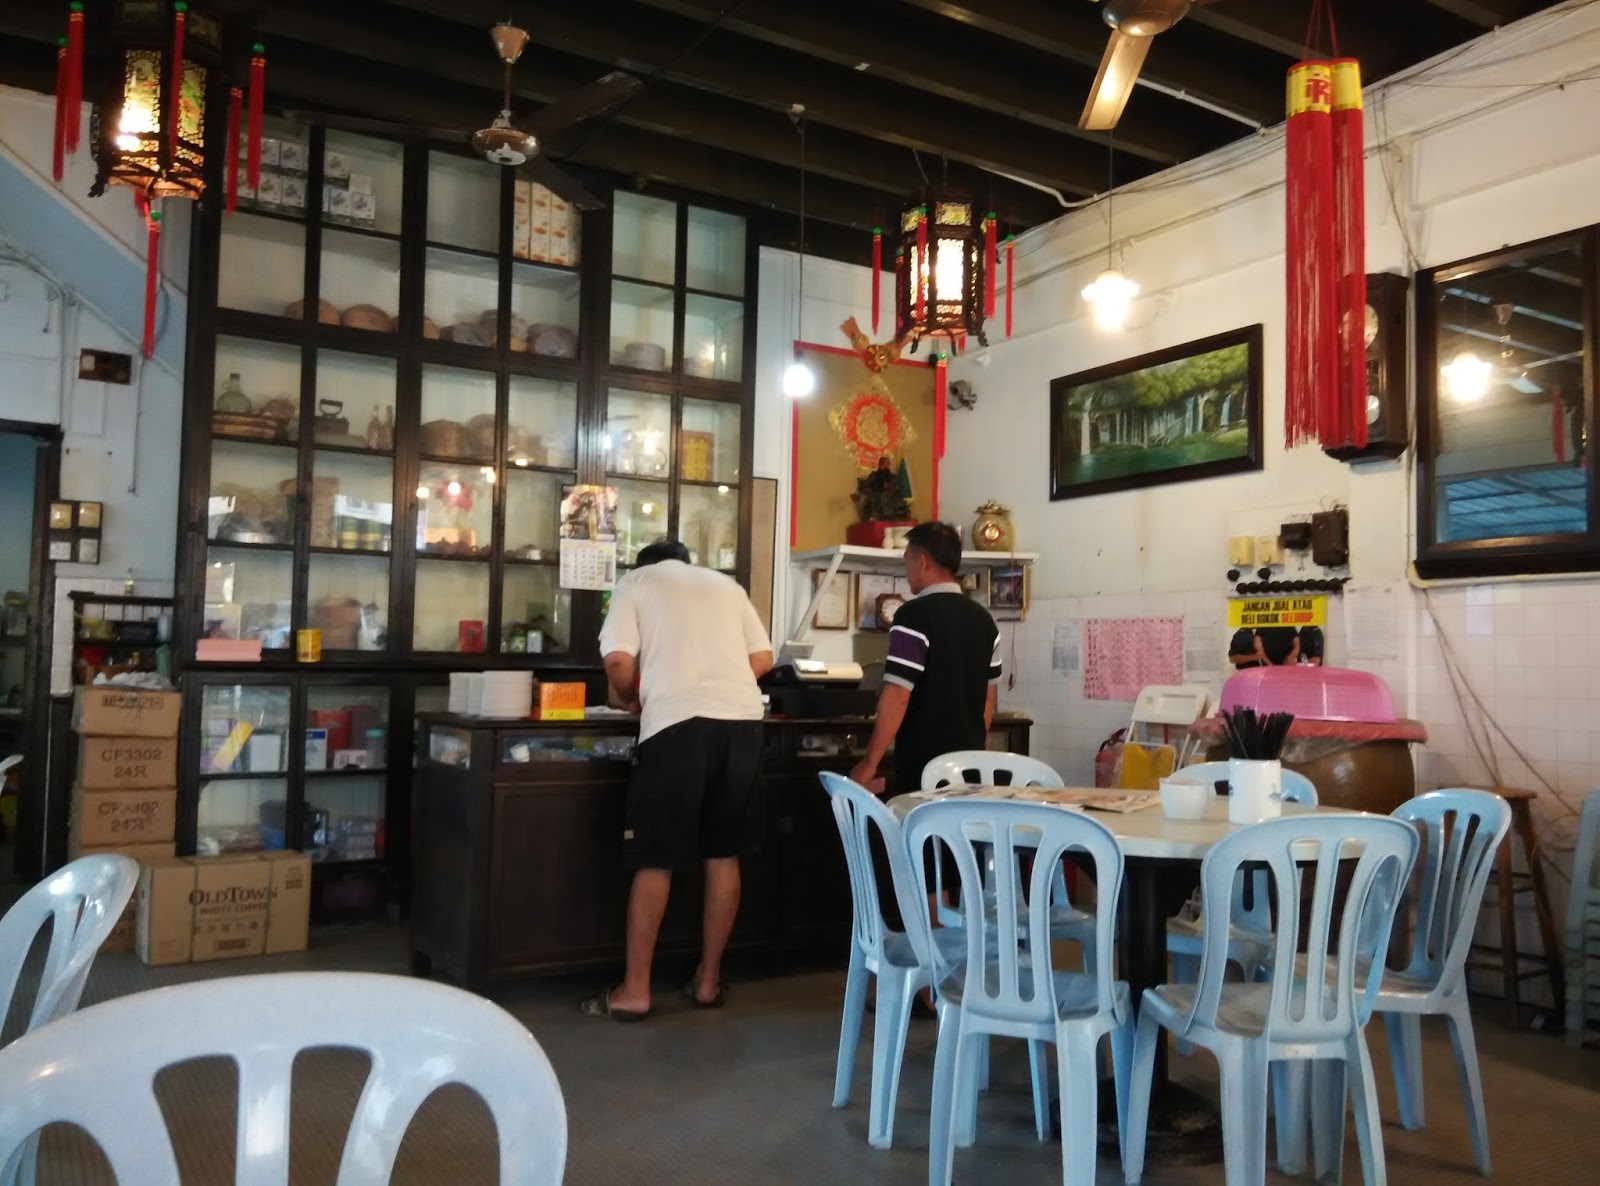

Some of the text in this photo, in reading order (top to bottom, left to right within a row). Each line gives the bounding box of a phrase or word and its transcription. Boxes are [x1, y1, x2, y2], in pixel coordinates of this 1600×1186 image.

[1242, 599, 1313, 612] JANGAN JUAL ATAU
[1241, 614, 1255, 624] BELI
[1256, 613, 1280, 623] ROKOK
[102, 749, 162, 761] CF3302
